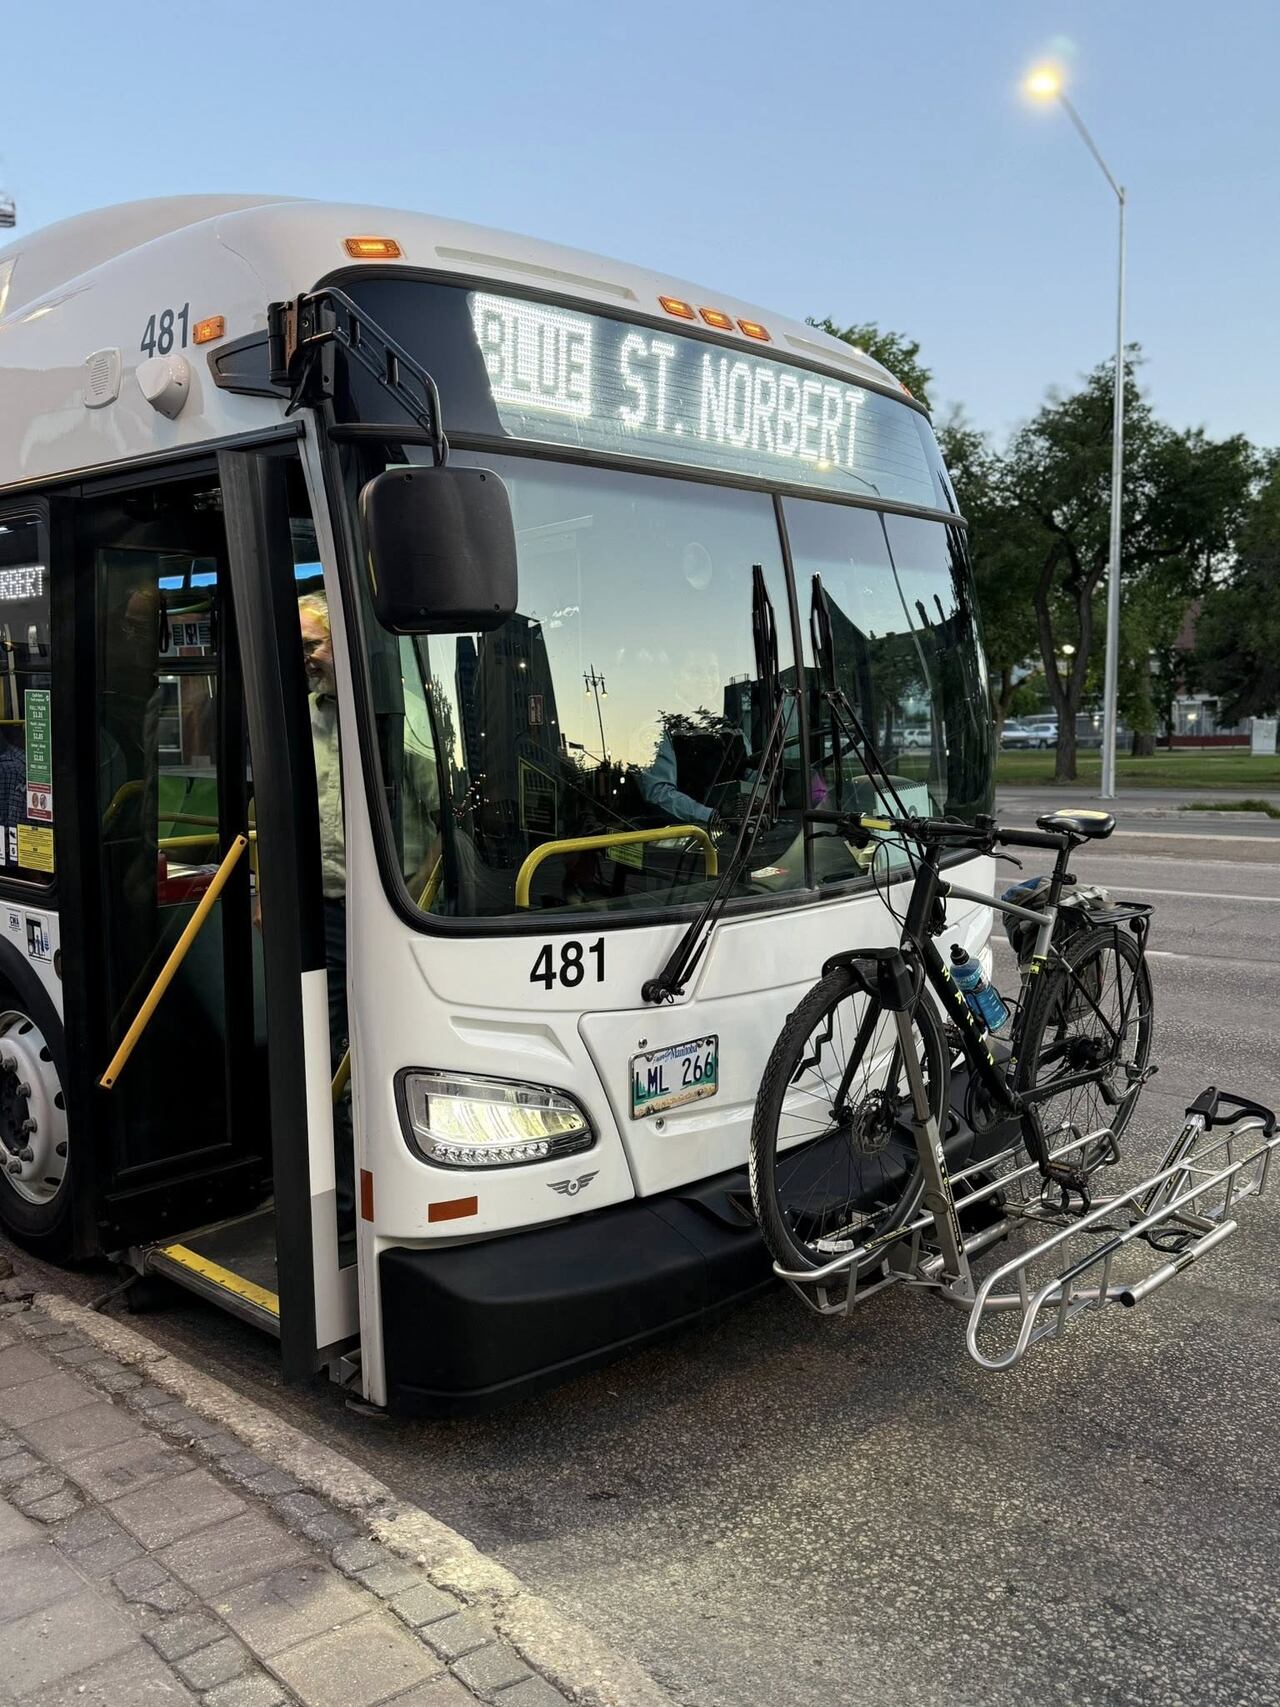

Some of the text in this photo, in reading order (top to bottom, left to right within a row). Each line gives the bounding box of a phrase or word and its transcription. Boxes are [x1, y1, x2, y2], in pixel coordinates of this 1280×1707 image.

[140, 302, 190, 358] 481
[479, 302, 866, 467] BLUE ST. NORBERT
[529, 937, 605, 991] 481
[635, 1064, 670, 1100] LML
[681, 1051, 714, 1087] 266
